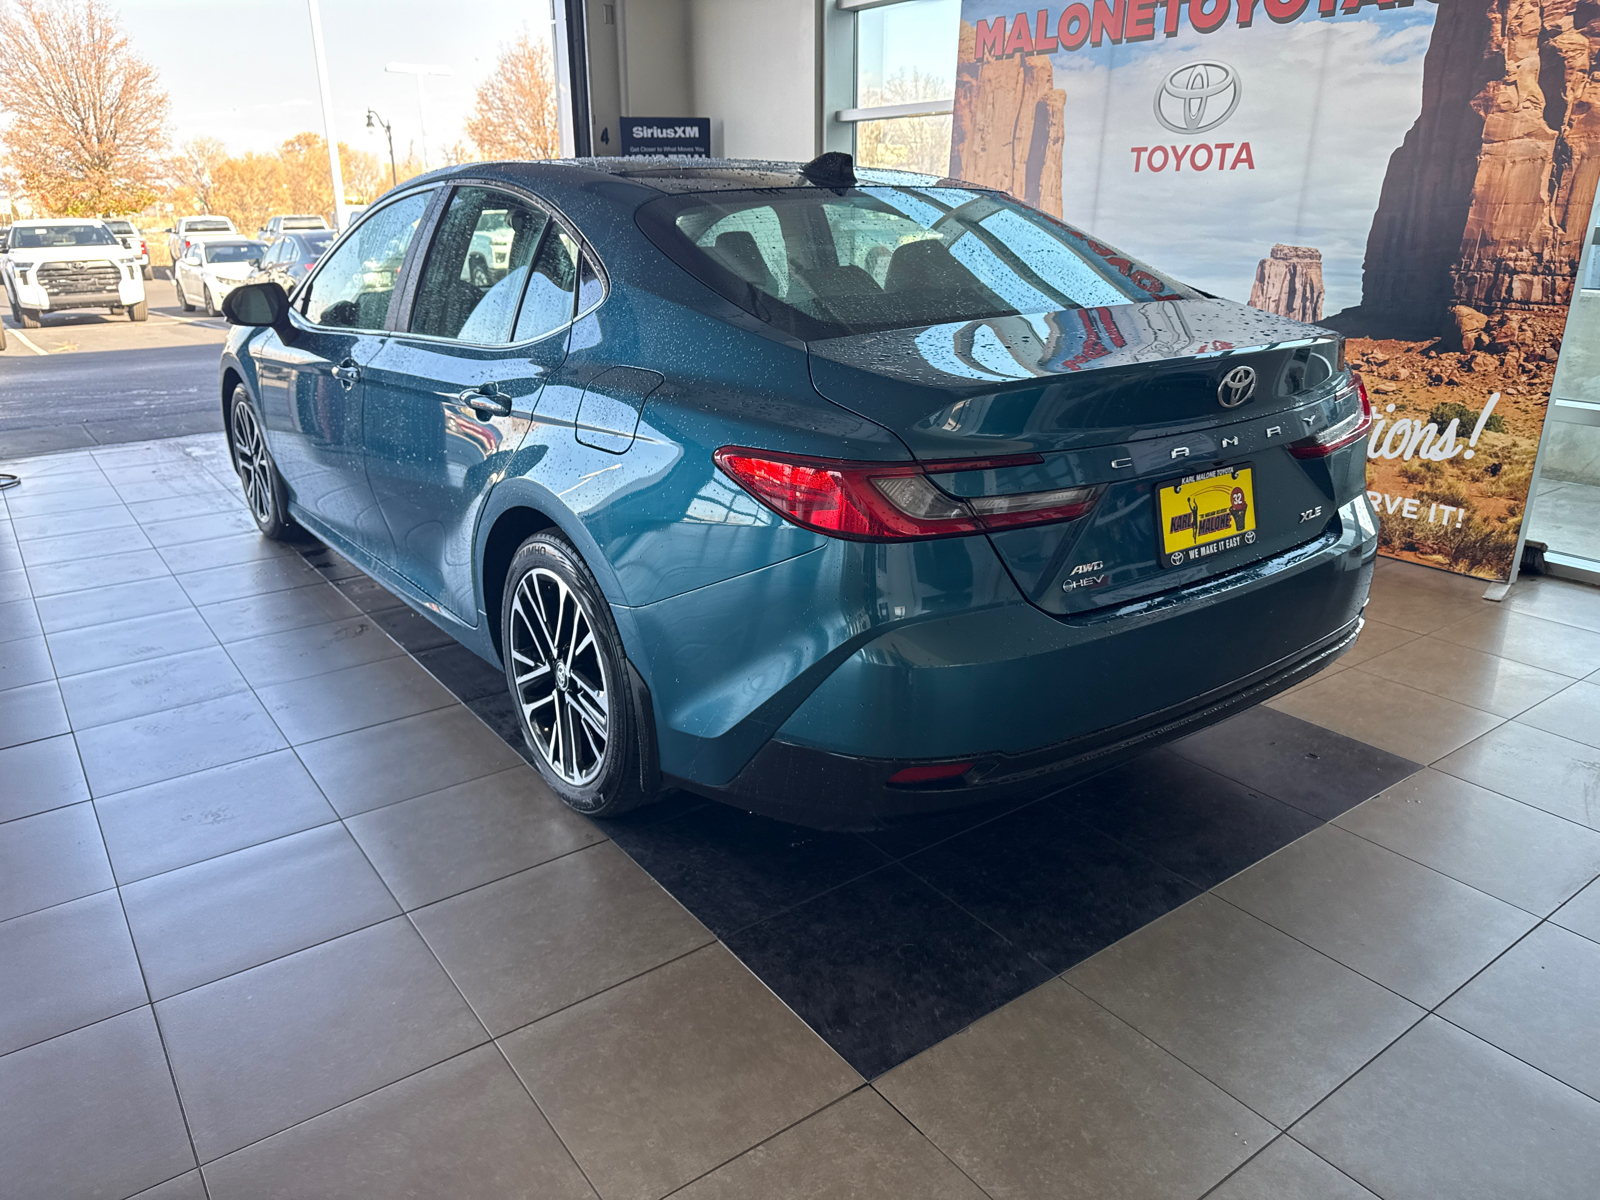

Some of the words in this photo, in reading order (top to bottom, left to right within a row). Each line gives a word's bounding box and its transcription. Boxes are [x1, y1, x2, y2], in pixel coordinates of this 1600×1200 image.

[974, 0, 1413, 62] MALONETOY
[600, 127, 610, 145] 4
[632, 126, 699, 138] SiriusXM
[1130, 142, 1255, 173] TOYOTA
[1367, 392, 1500, 461] ions!
[1111, 413, 1316, 470] CAMRY
[1181, 475, 1195, 485] KARL
[1196, 470, 1216, 482] MALONE
[1217, 466, 1234, 477] TOYOTA
[1232, 492, 1243, 505] 32
[1170, 512, 1193, 535] KARL
[1198, 512, 1232, 537] MALONE
[1299, 505, 1323, 524] XLE
[1428, 503, 1465, 528] IT!
[1188, 548, 1199, 560] WE
[1200, 543, 1218, 557] MAKE
[1218, 541, 1225, 551] IT
[1225, 536, 1240, 549] EASY
[1069, 560, 1104, 577] AWD
